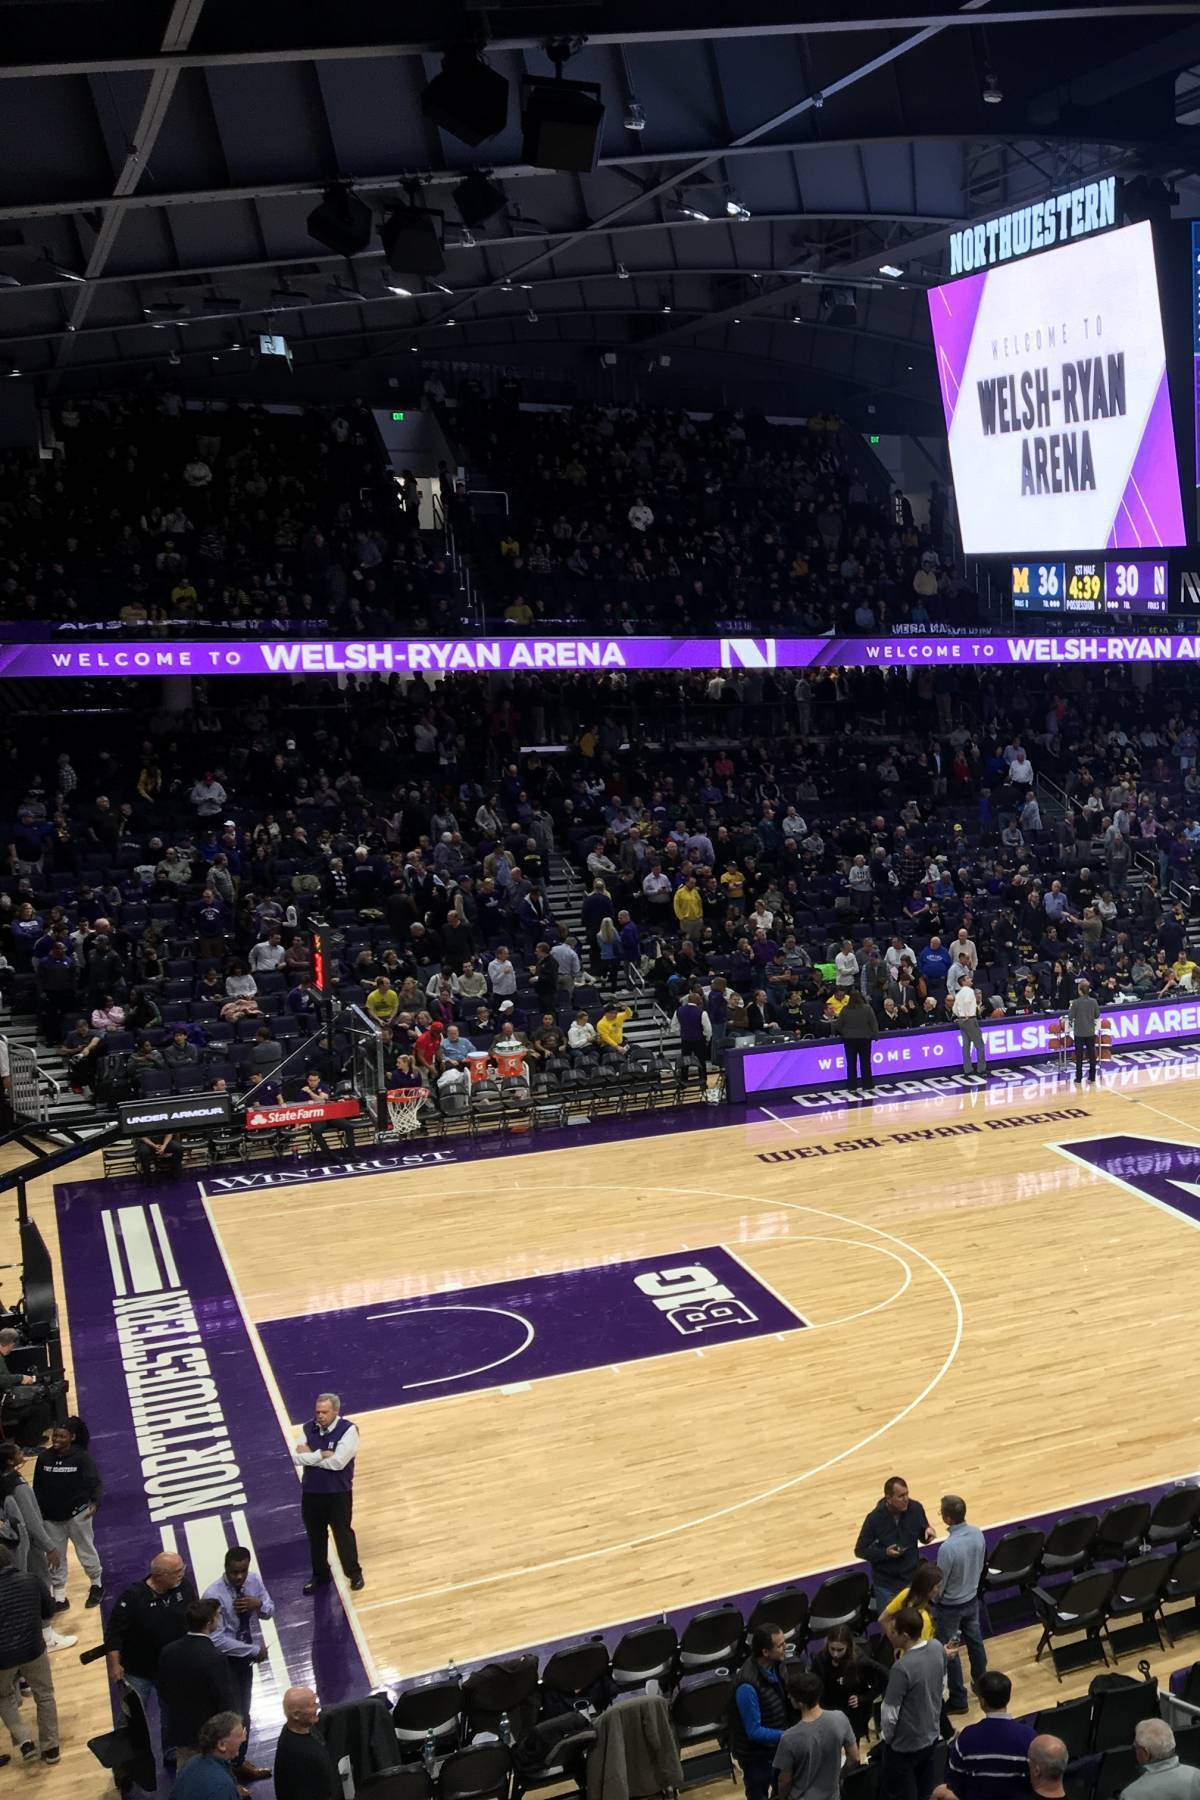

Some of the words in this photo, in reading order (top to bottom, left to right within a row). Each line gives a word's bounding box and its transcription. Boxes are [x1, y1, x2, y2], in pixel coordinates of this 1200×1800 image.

[950, 176, 1115, 276] NORTHWESTERN
[992, 324, 1067, 360] WELCOME
[1084, 315, 1102, 339] TO
[977, 352, 1126, 436] WELSH-RYAN
[1021, 430, 1096, 496] ARENA
[1038, 566, 1058, 596] 36
[1084, 565, 1096, 575] HALF
[1116, 565, 1139, 596] 30
[1154, 566, 1165, 594] N
[1069, 575, 1101, 599] 4:39
[1066, 600, 1095, 610] POSSESSION
[52, 651, 192, 667] WELCOME
[209, 651, 241, 665] TO
[260, 642, 500, 671] WELSH-RYAN
[508, 641, 626, 667] ARENA
[866, 644, 961, 658] WELCOME
[973, 644, 995, 657] TO
[1007, 638, 1172, 661] WELSH-RYAN
[818, 1048, 912, 1070] WEOME
[922, 1045, 944, 1057] TO
[127, 1111, 169, 1126] UNDER
[755, 1122, 982, 1163] WELSH-RYAN
[985, 1108, 1092, 1131] ARENA
[210, 1150, 455, 1188] WINTRUST
[113, 1289, 248, 1522] NORTHWESTERN
